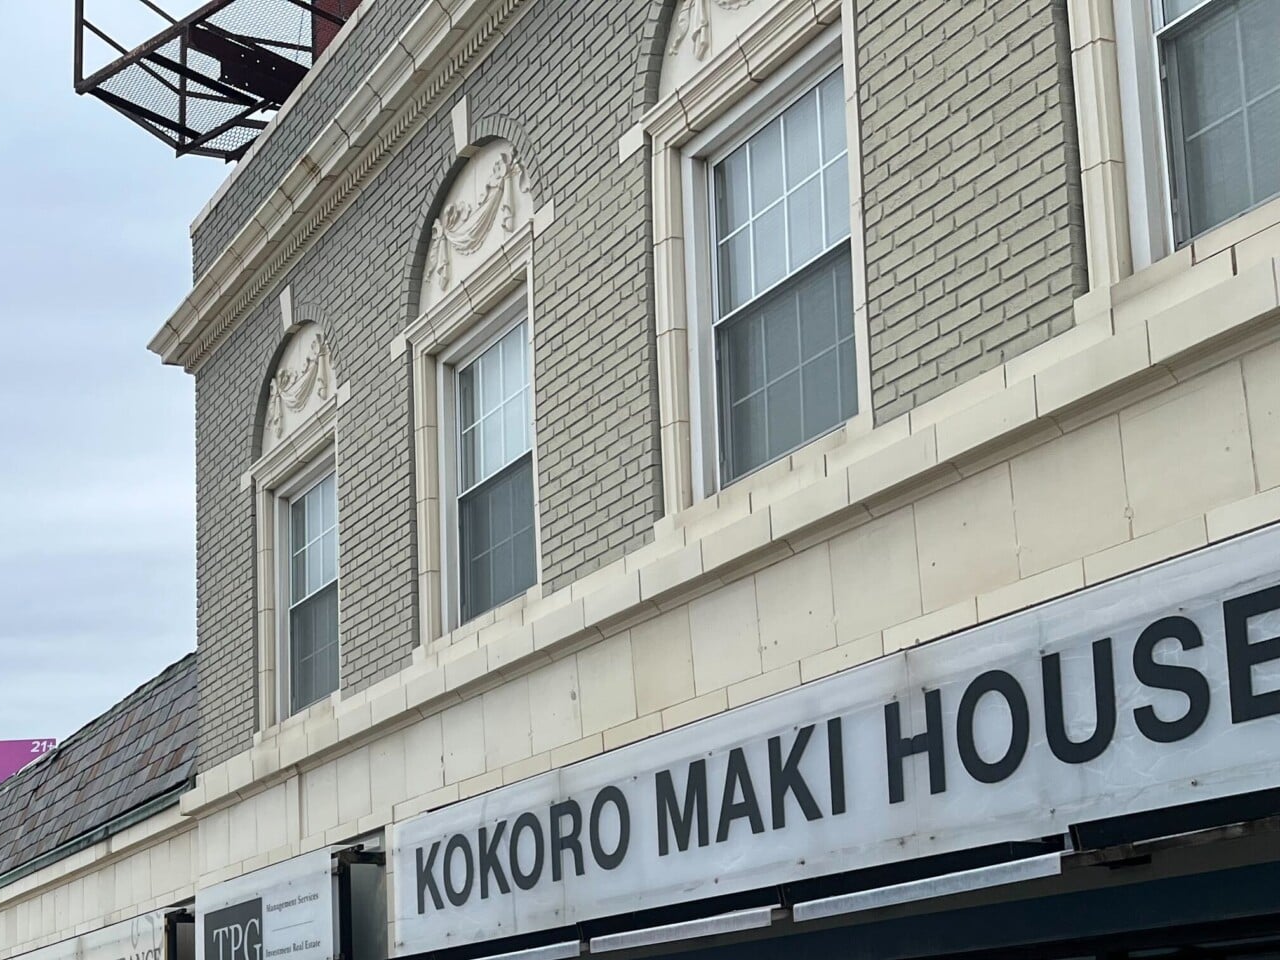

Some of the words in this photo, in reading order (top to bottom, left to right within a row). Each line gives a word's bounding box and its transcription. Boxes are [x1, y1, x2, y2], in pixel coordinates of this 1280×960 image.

[415, 785, 631, 916] KOKORO
[655, 717, 848, 857] MAKI
[884, 585, 1280, 805] HOUSE
[266, 898, 297, 912] Management
[298, 893, 319, 904] Services
[265, 945, 291, 958] Investment
[293, 941, 304, 952] Real
[305, 940, 321, 950] Estate
